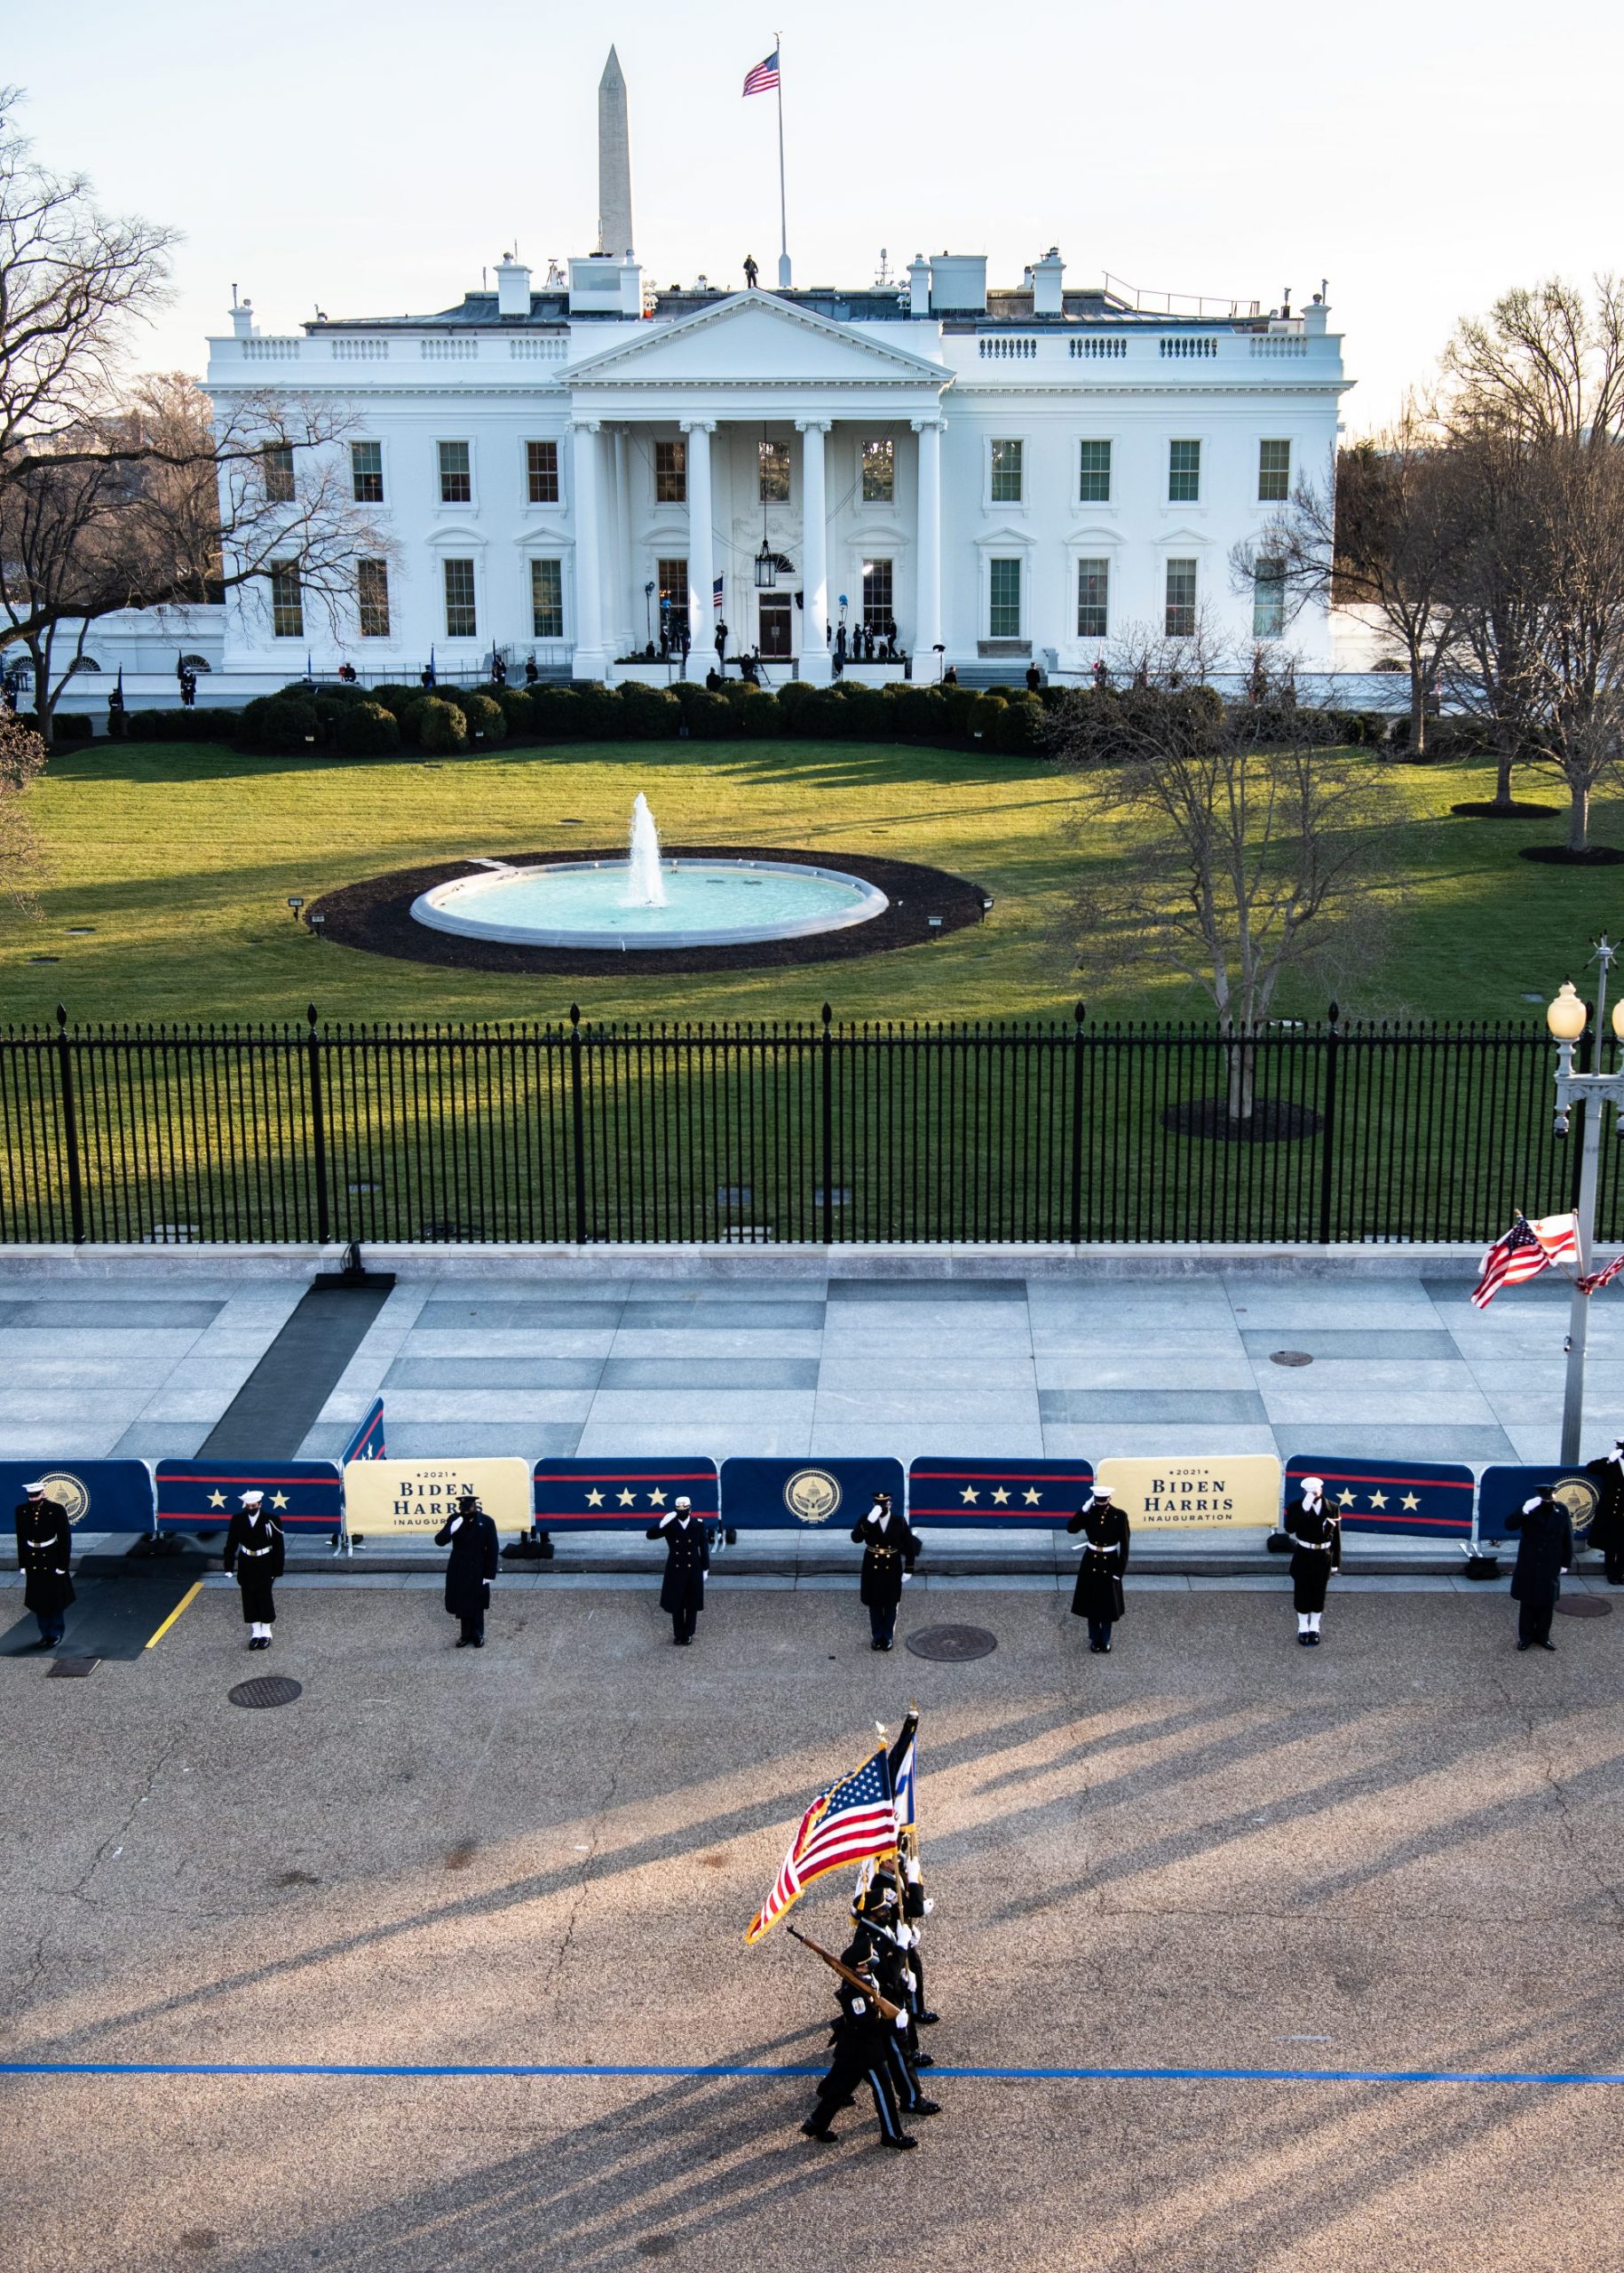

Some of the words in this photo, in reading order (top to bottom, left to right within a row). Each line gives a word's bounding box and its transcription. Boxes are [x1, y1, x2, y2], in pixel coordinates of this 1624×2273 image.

[400, 1482, 474, 1496] BIDEN
[1152, 1479, 1225, 1493] BIDEN
[393, 1501, 483, 1515] HARRS
[1144, 1497, 1233, 1511] HARRIS
